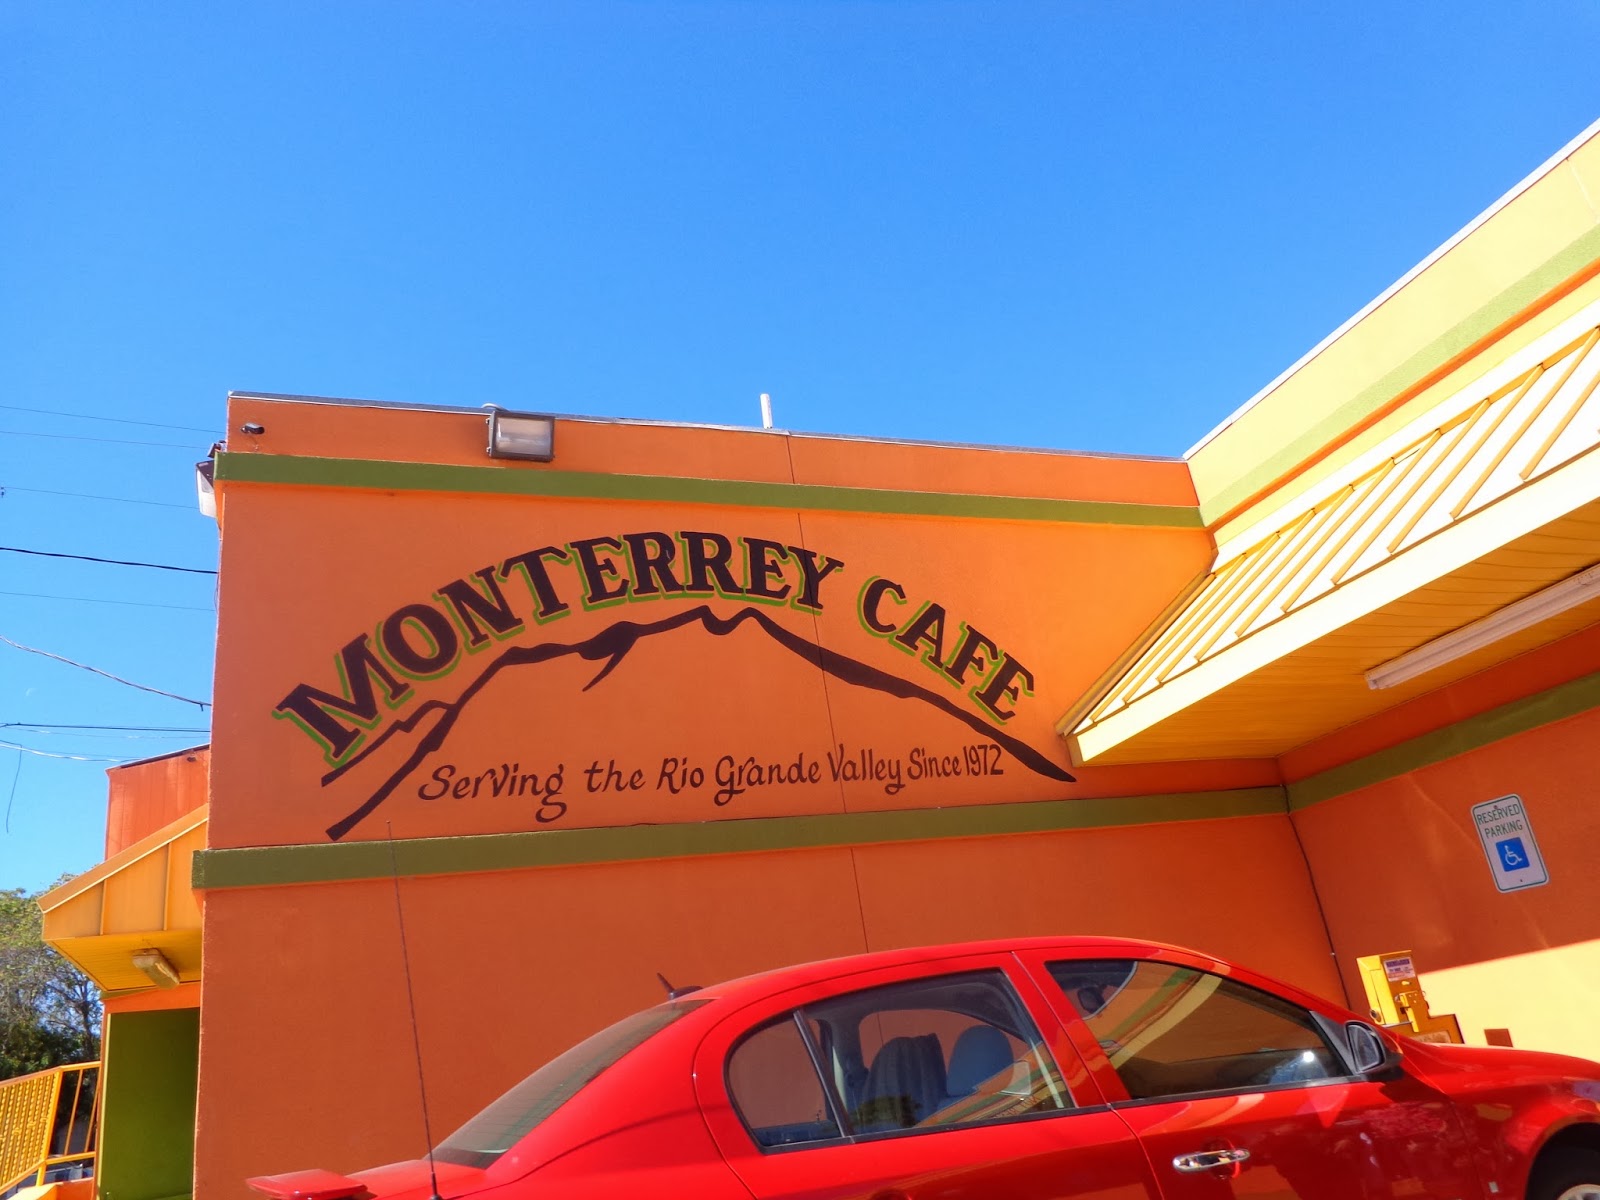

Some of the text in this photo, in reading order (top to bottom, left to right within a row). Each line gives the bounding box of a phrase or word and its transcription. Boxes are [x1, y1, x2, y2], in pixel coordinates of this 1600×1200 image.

[272, 531, 1035, 769] MONTERREY CAFE
[418, 743, 1004, 823] Serving the Rio Grande Valley Since 1972
[1476, 804, 1520, 825] RESERVED
[1484, 820, 1523, 838] PARKING
